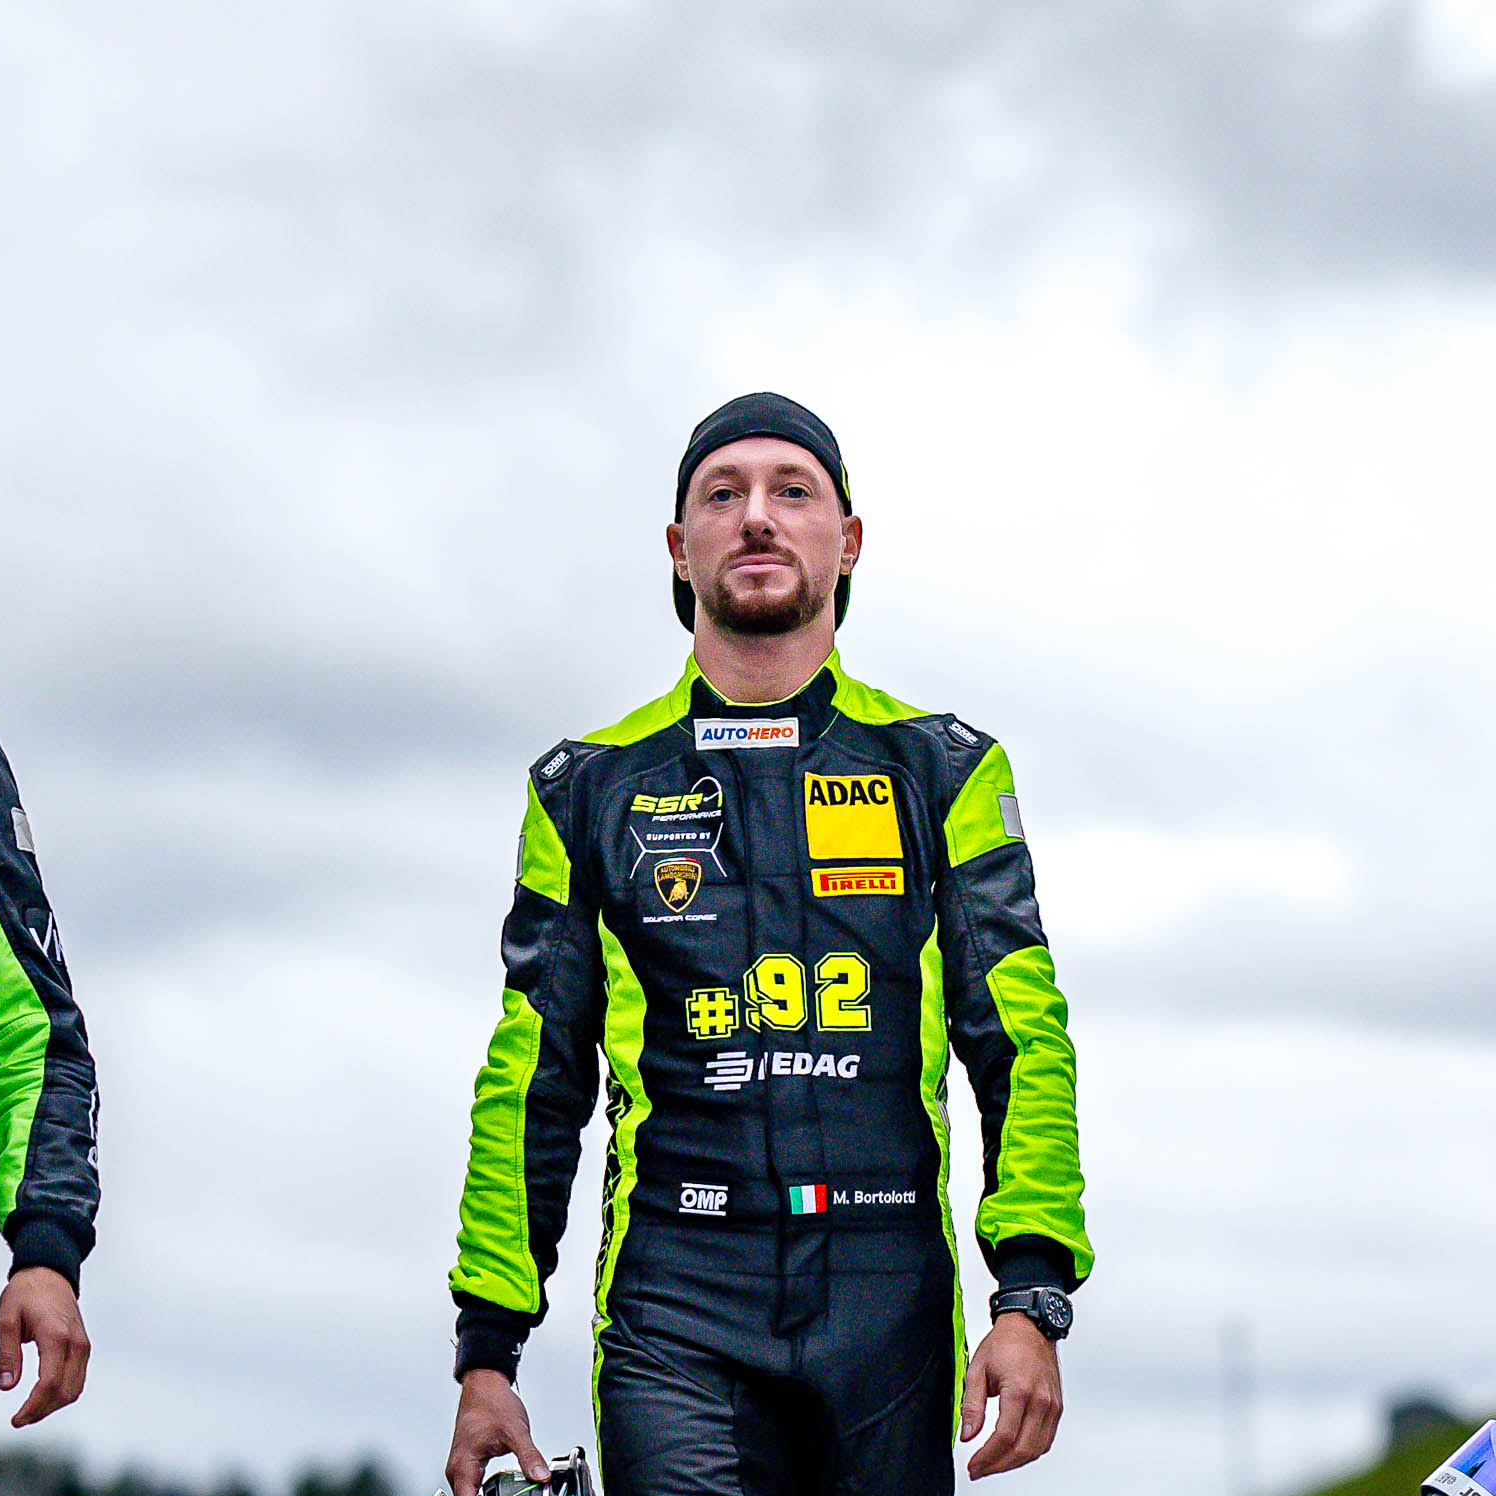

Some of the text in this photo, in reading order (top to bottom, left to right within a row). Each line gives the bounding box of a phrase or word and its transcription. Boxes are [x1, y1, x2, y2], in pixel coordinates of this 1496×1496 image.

[701, 726, 794, 741] AUTOHERO
[808, 778, 889, 806] ADAC
[630, 793, 704, 814] SSR
[651, 809, 723, 822] PERFORMANCE
[646, 832, 711, 841] SUPPORTED BY
[819, 872, 896, 891] PIRELLI
[762, 1052, 861, 1080] EDAG
[679, 1187, 729, 1212] OMP
[832, 1189, 916, 1205] M. Bortolotti
